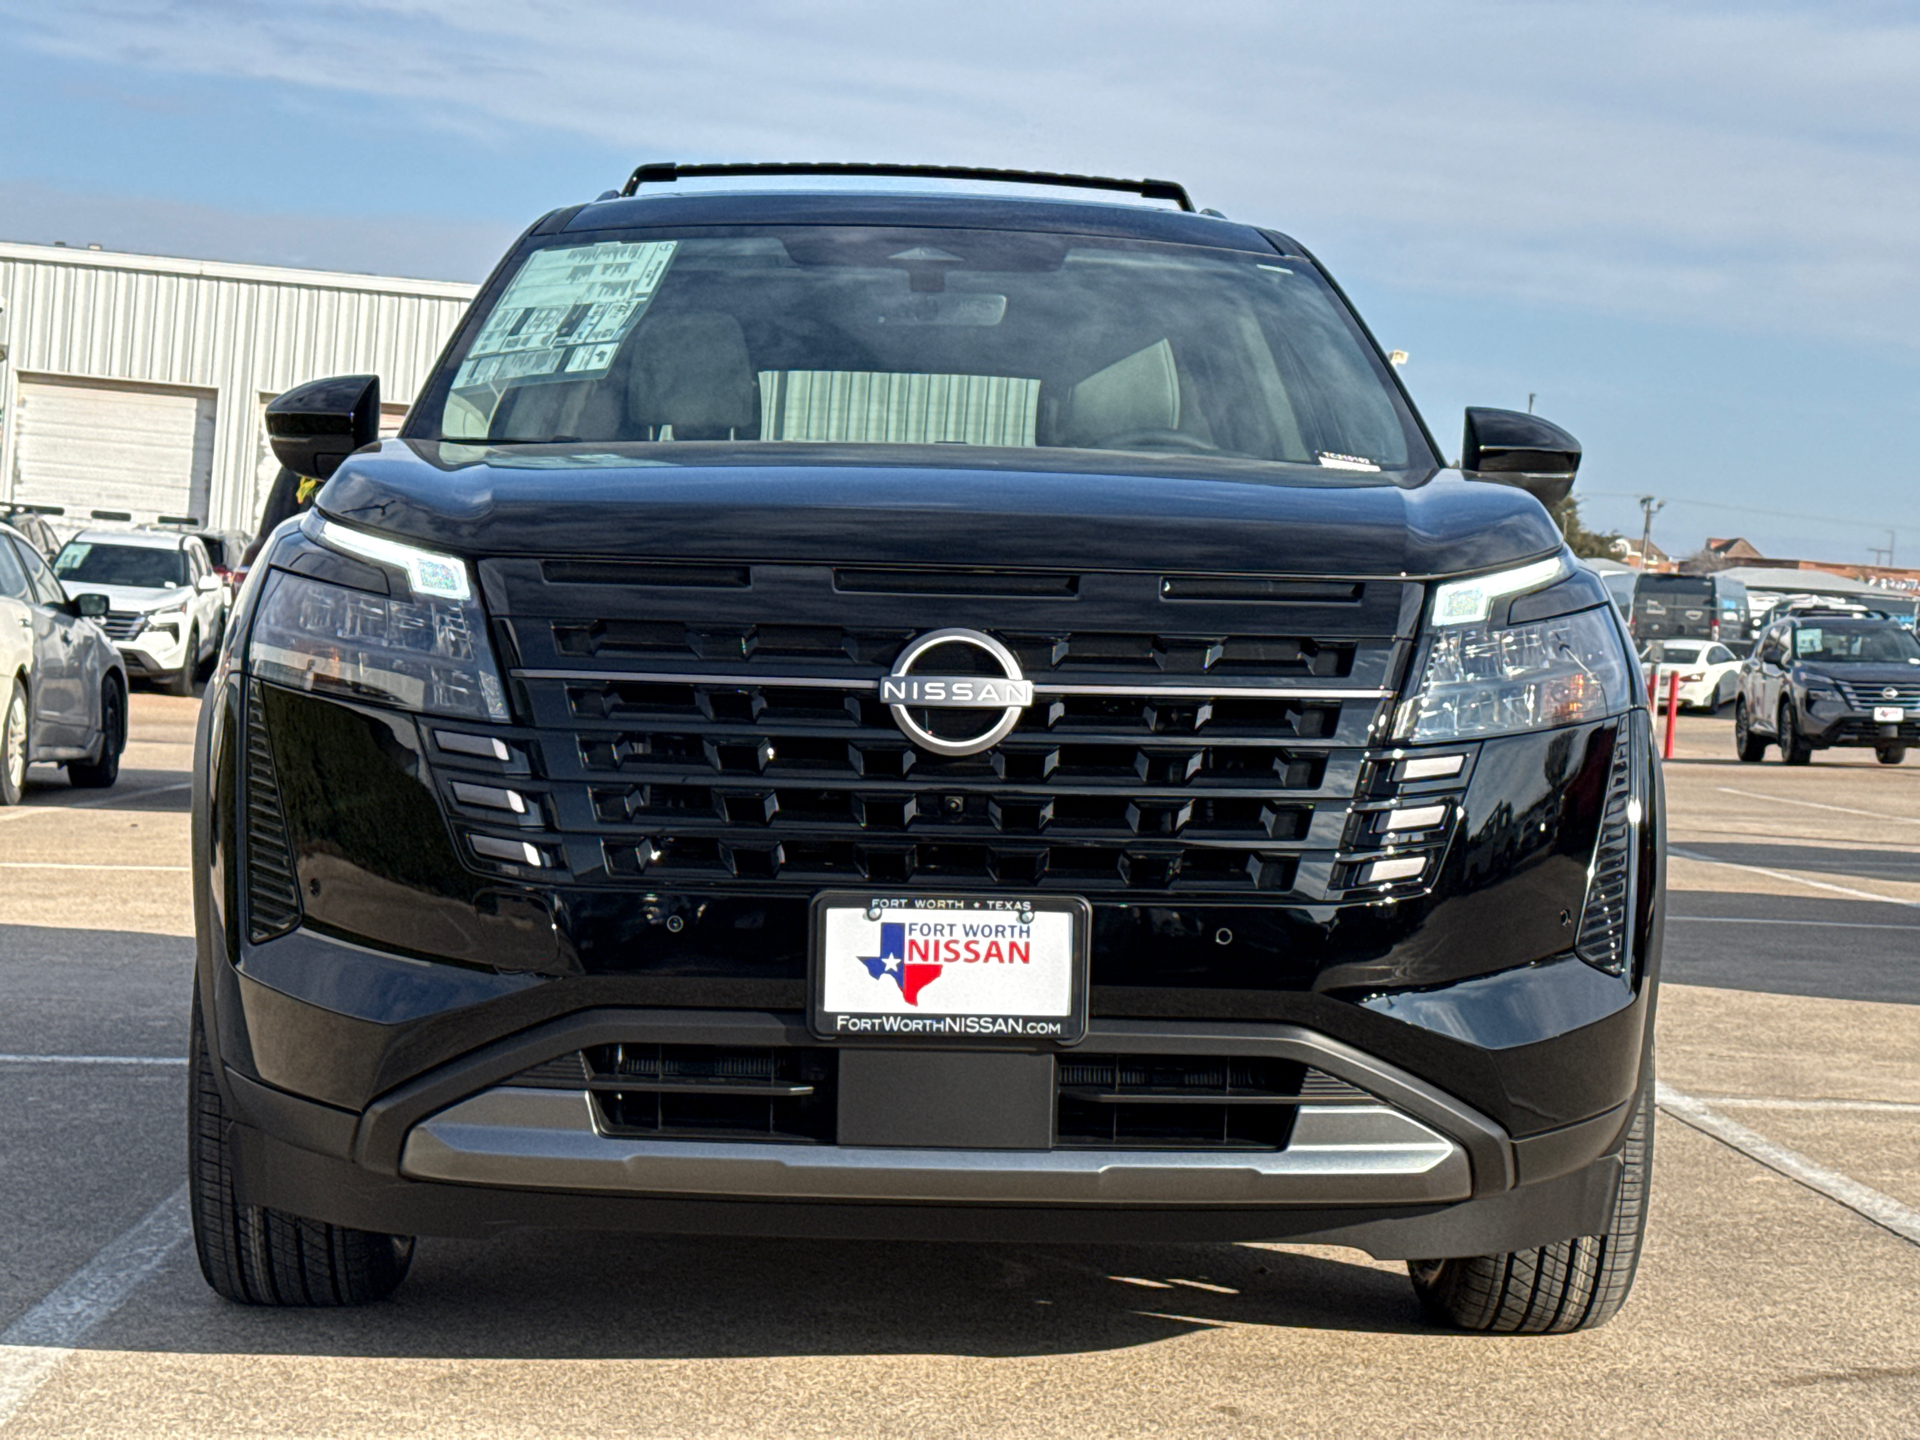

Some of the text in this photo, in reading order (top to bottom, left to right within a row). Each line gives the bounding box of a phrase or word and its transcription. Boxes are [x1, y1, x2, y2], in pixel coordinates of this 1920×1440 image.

[884, 681, 1029, 702] NISSAN
[871, 898, 1032, 911] FORT WORTH TEXAS
[908, 922, 1031, 939] FORT WORTH
[907, 938, 1030, 964] NISSAN
